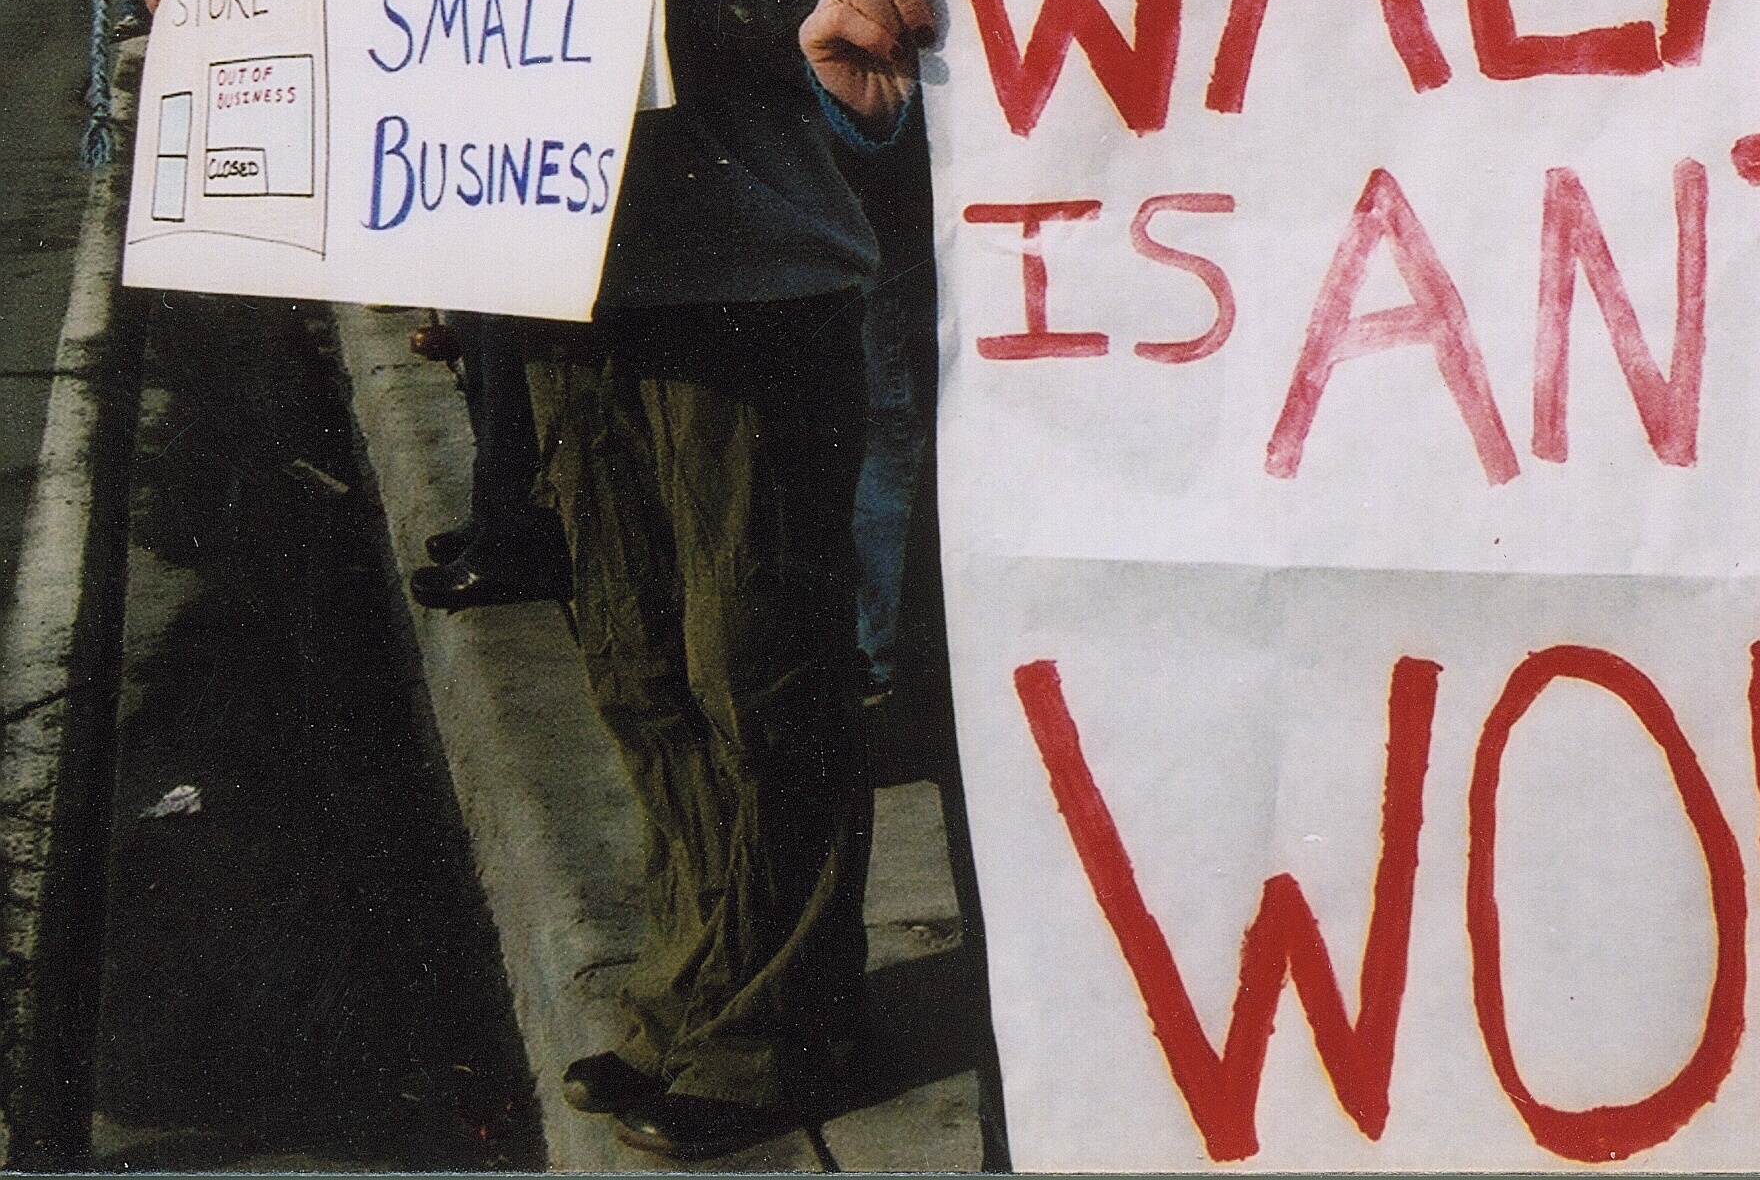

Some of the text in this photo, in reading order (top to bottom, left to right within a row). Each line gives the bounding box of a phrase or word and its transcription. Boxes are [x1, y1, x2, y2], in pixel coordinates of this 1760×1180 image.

[216, 66, 274, 87] OUT OF
[216, 86, 297, 111] BUSINESS
[205, 158, 260, 180] CLOSED
[360, 115, 616, 232] BUSINESS
[963, 192, 1237, 366] IS
